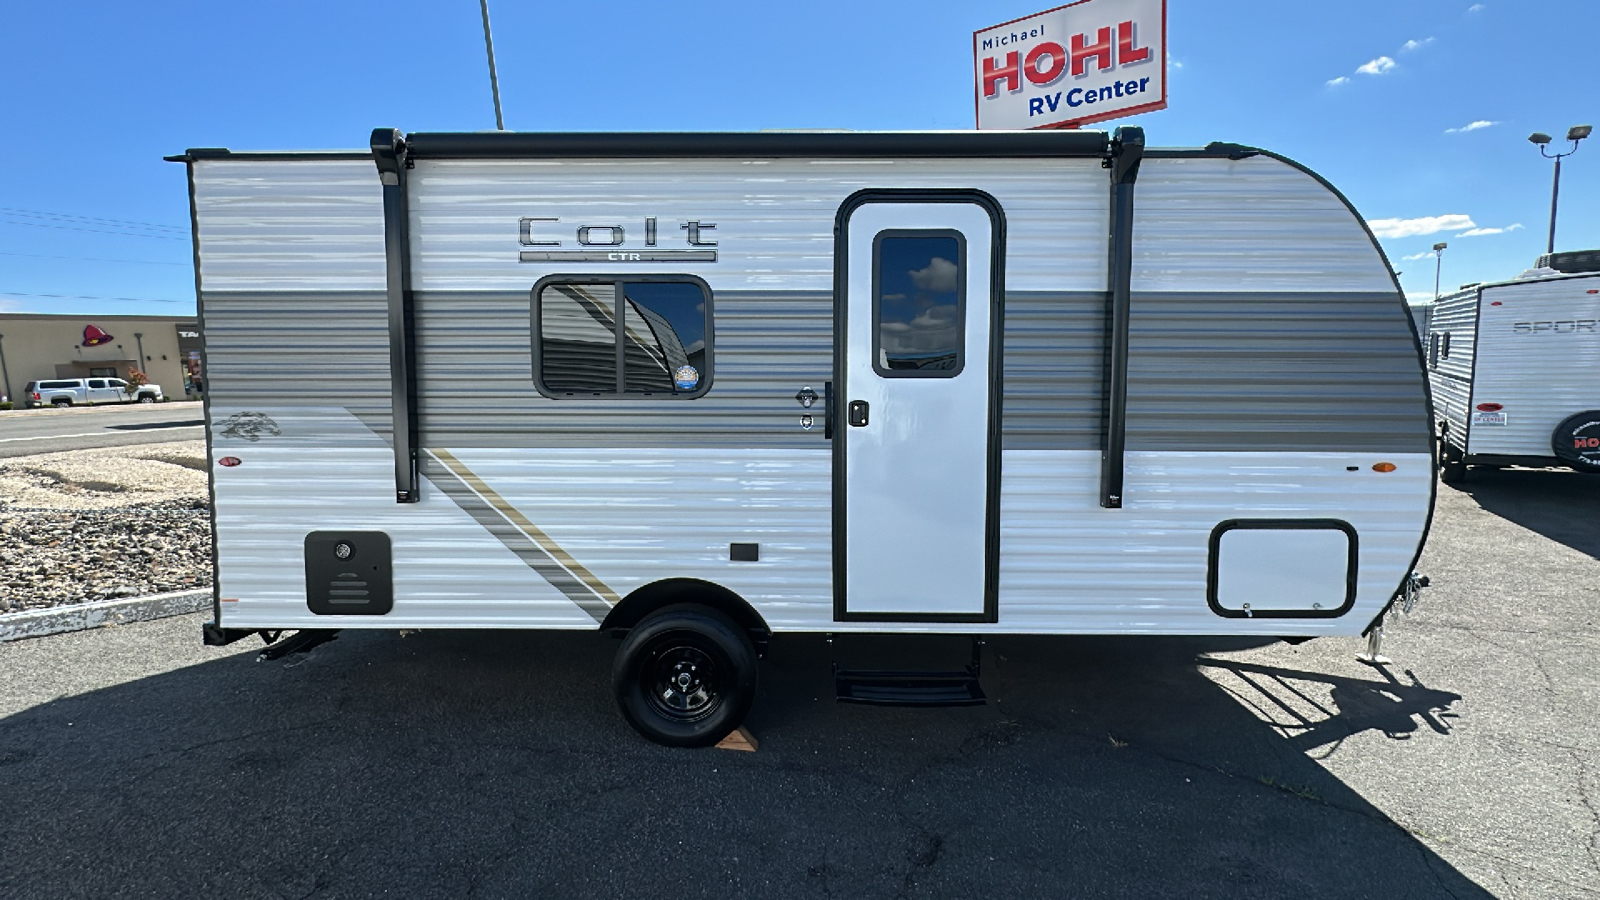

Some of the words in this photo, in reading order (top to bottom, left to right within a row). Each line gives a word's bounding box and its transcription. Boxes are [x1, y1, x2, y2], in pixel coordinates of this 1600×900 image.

[982, 25, 1044, 50] Michael
[982, 20, 1151, 98] HOHL
[1029, 91, 1062, 117] RV
[1066, 77, 1150, 108] Center
[518, 216, 719, 247] Colt
[607, 252, 641, 261] CTR
[1513, 319, 1600, 334] SPOR
